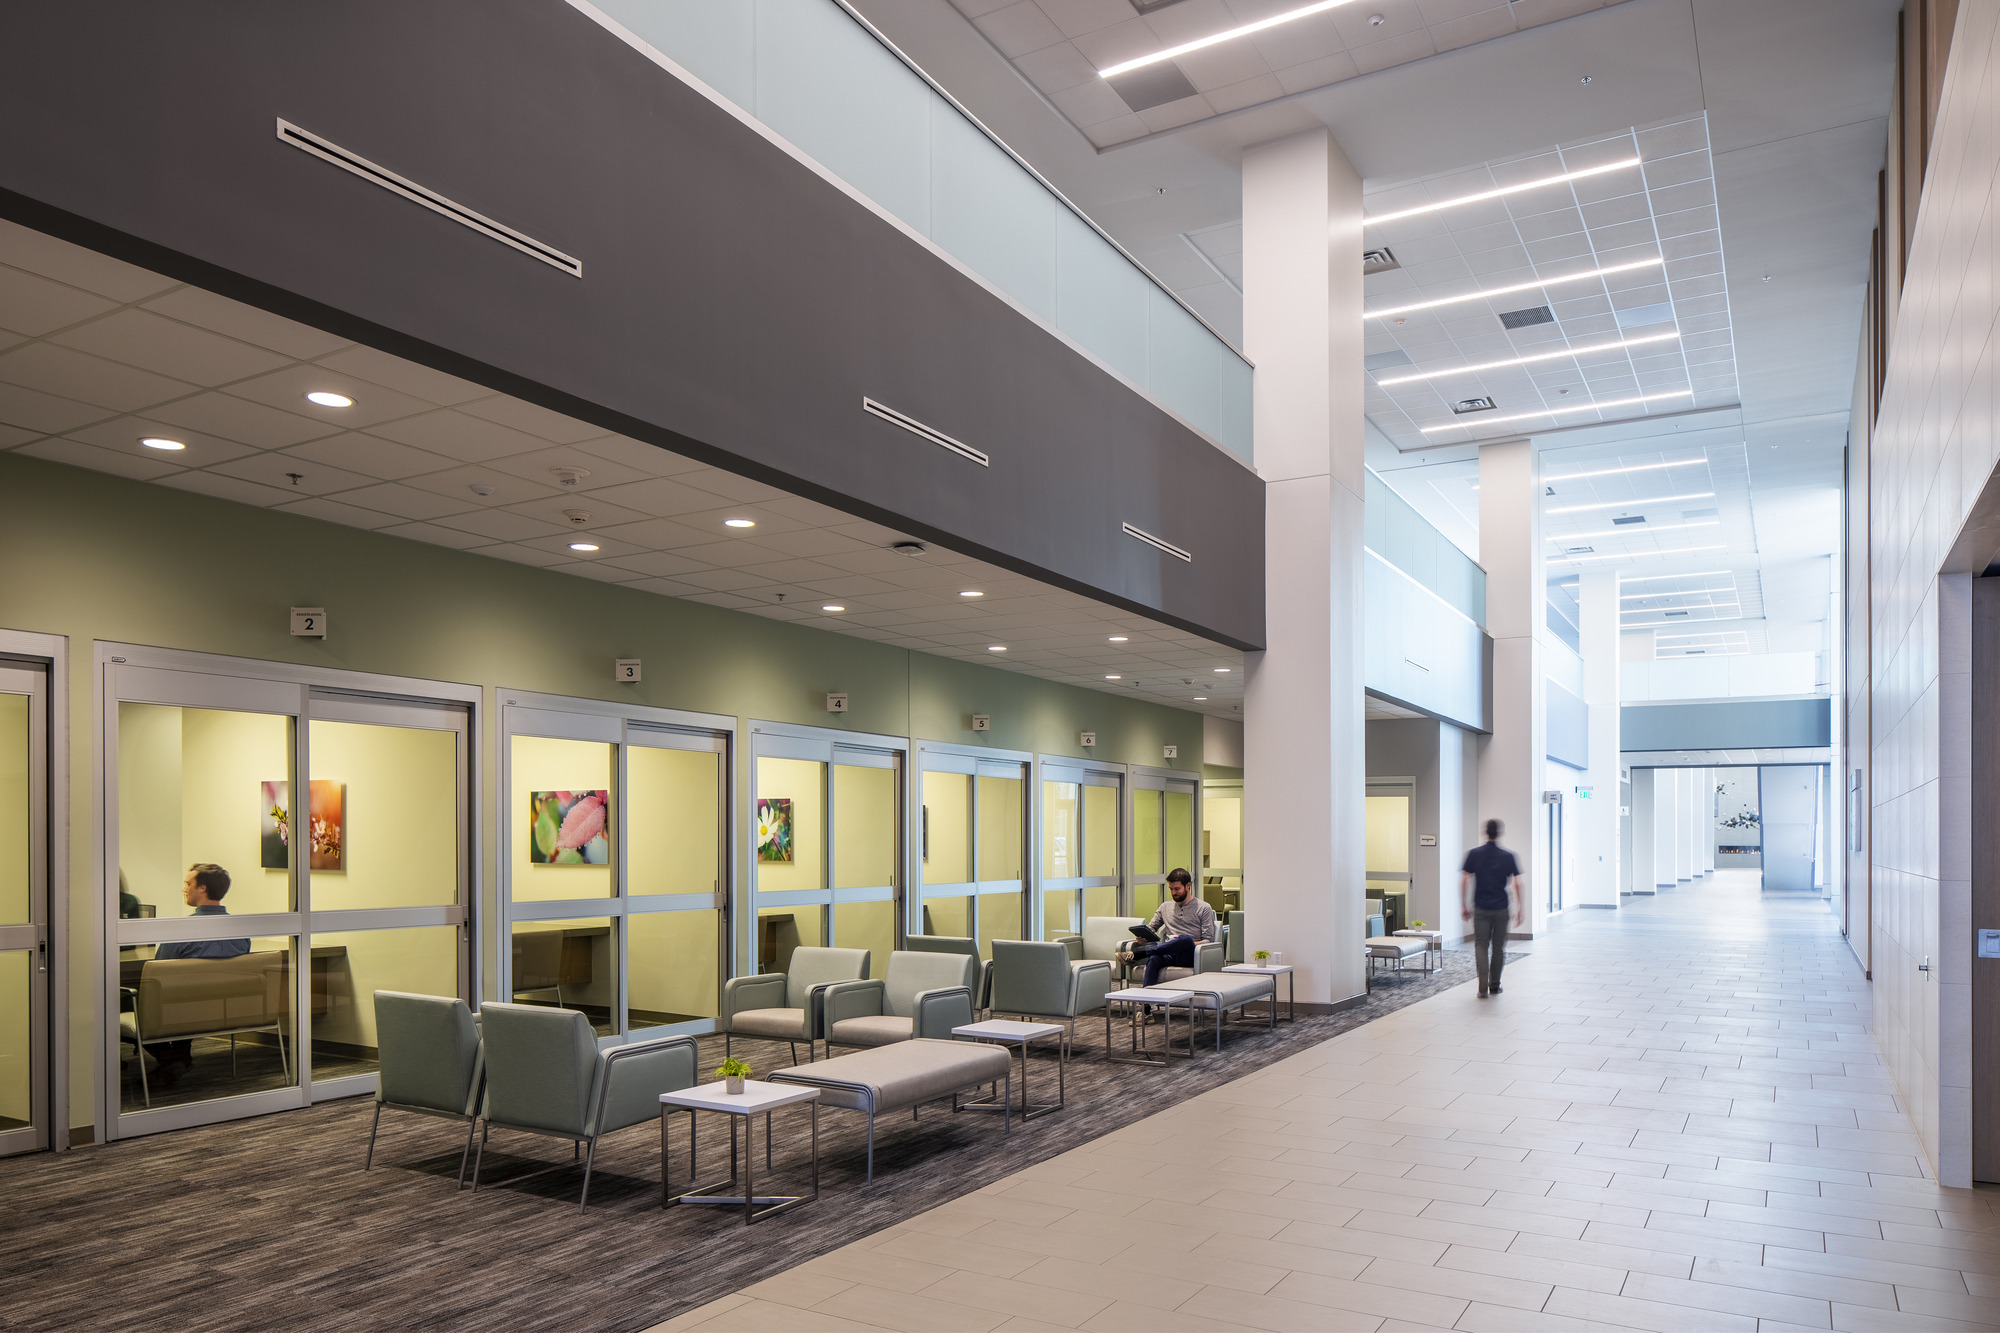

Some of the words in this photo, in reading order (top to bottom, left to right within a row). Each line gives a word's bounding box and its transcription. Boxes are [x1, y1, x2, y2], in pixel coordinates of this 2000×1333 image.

[304, 617, 314, 630] 2
[626, 667, 634, 677] 3
[834, 699, 842, 708] 4
[979, 720, 985, 728] 5
